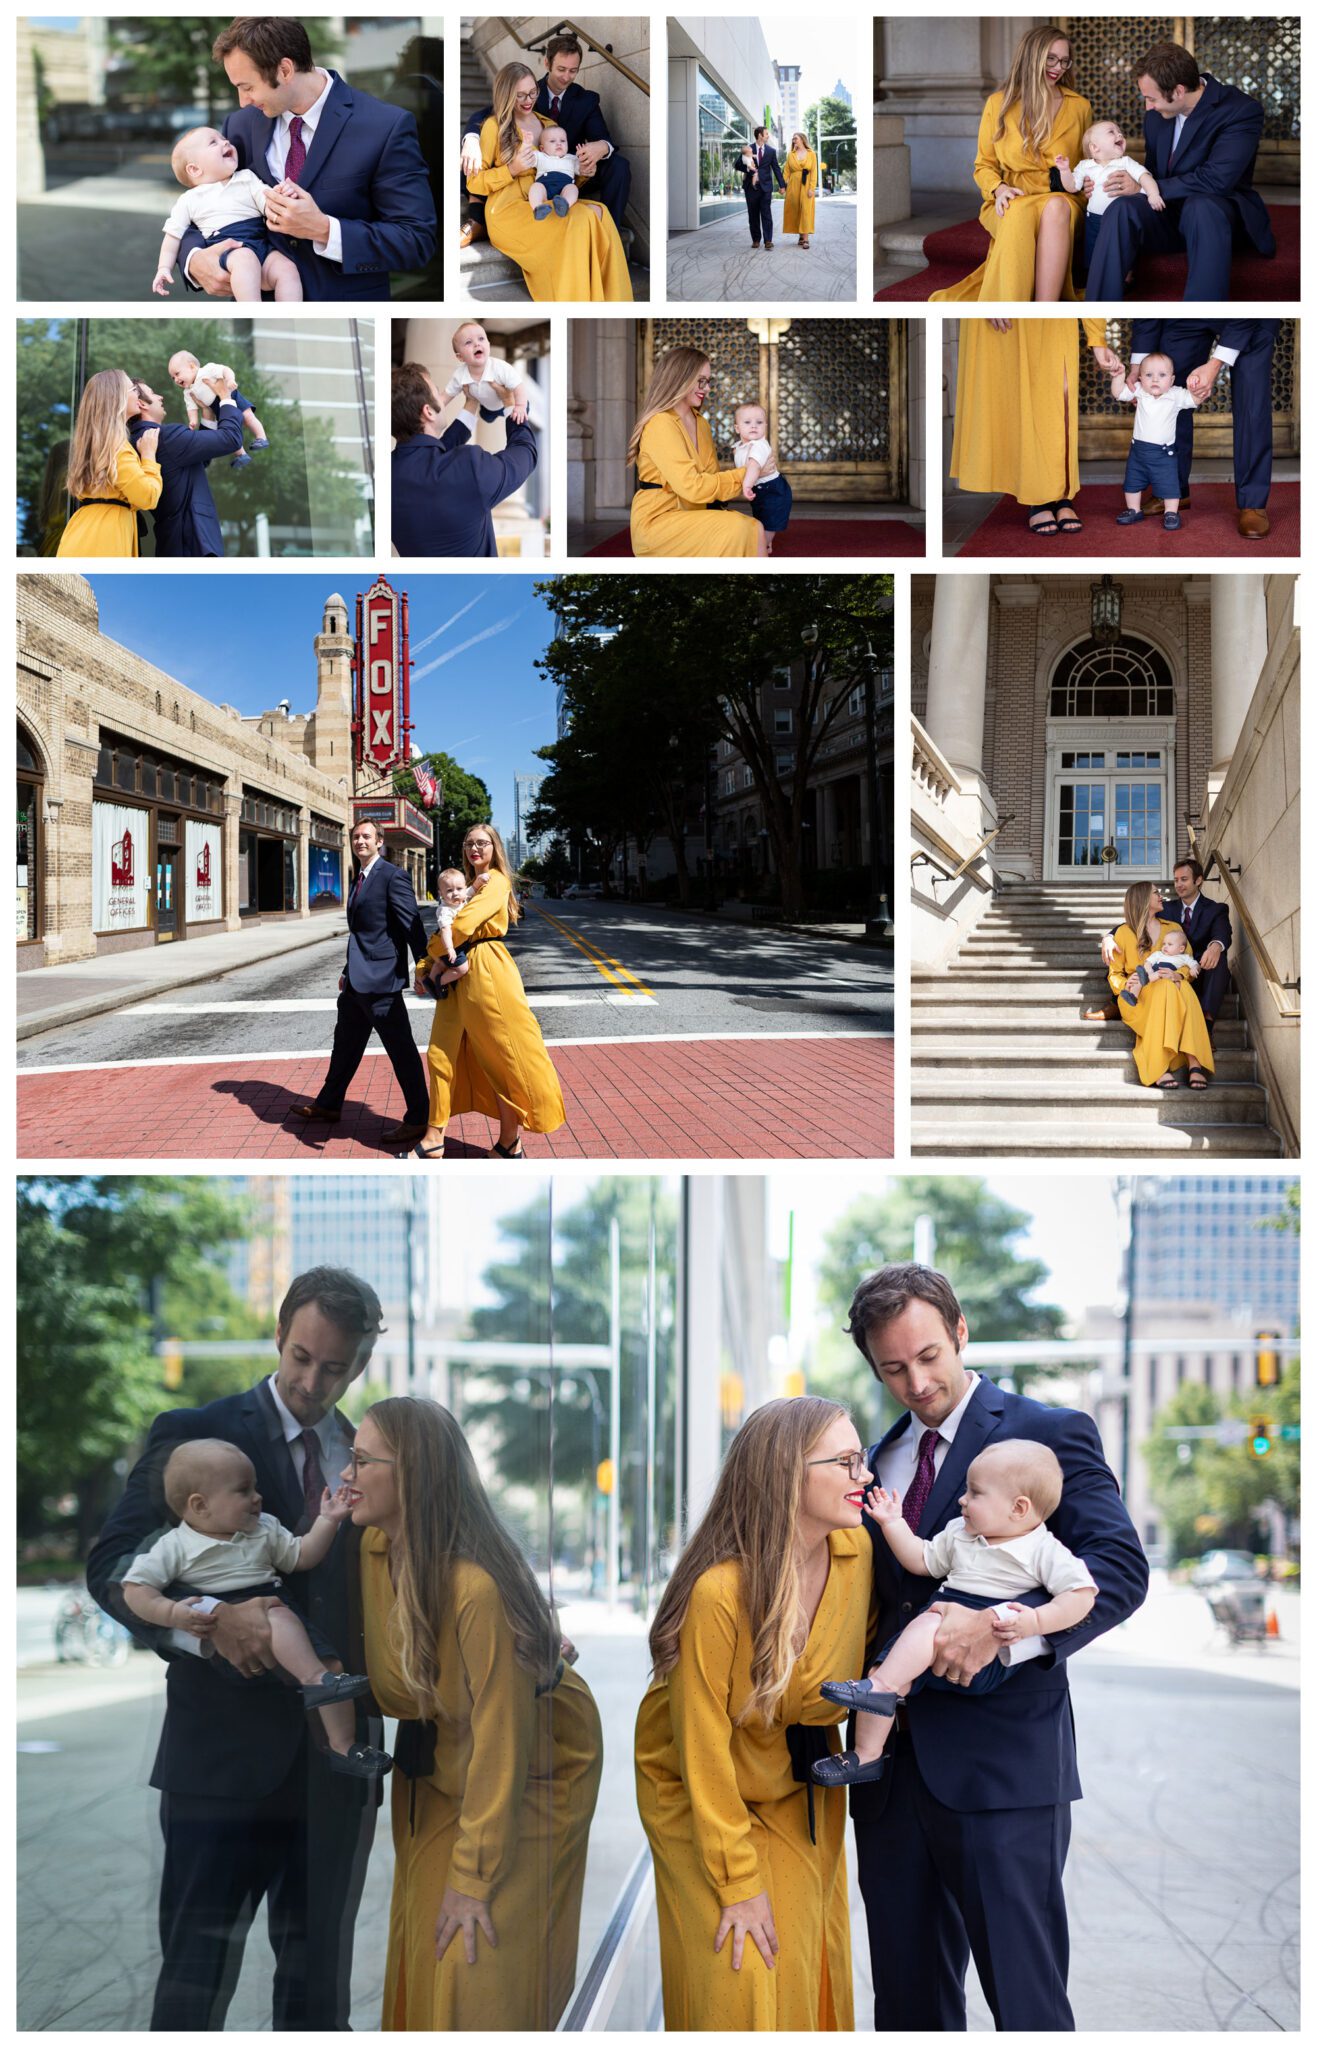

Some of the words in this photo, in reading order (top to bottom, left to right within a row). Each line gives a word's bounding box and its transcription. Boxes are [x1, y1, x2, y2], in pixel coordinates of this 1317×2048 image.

[370, 609, 392, 745] FOX
[108, 897, 135, 905] GENERAL
[110, 907, 135, 916] OFFICES
